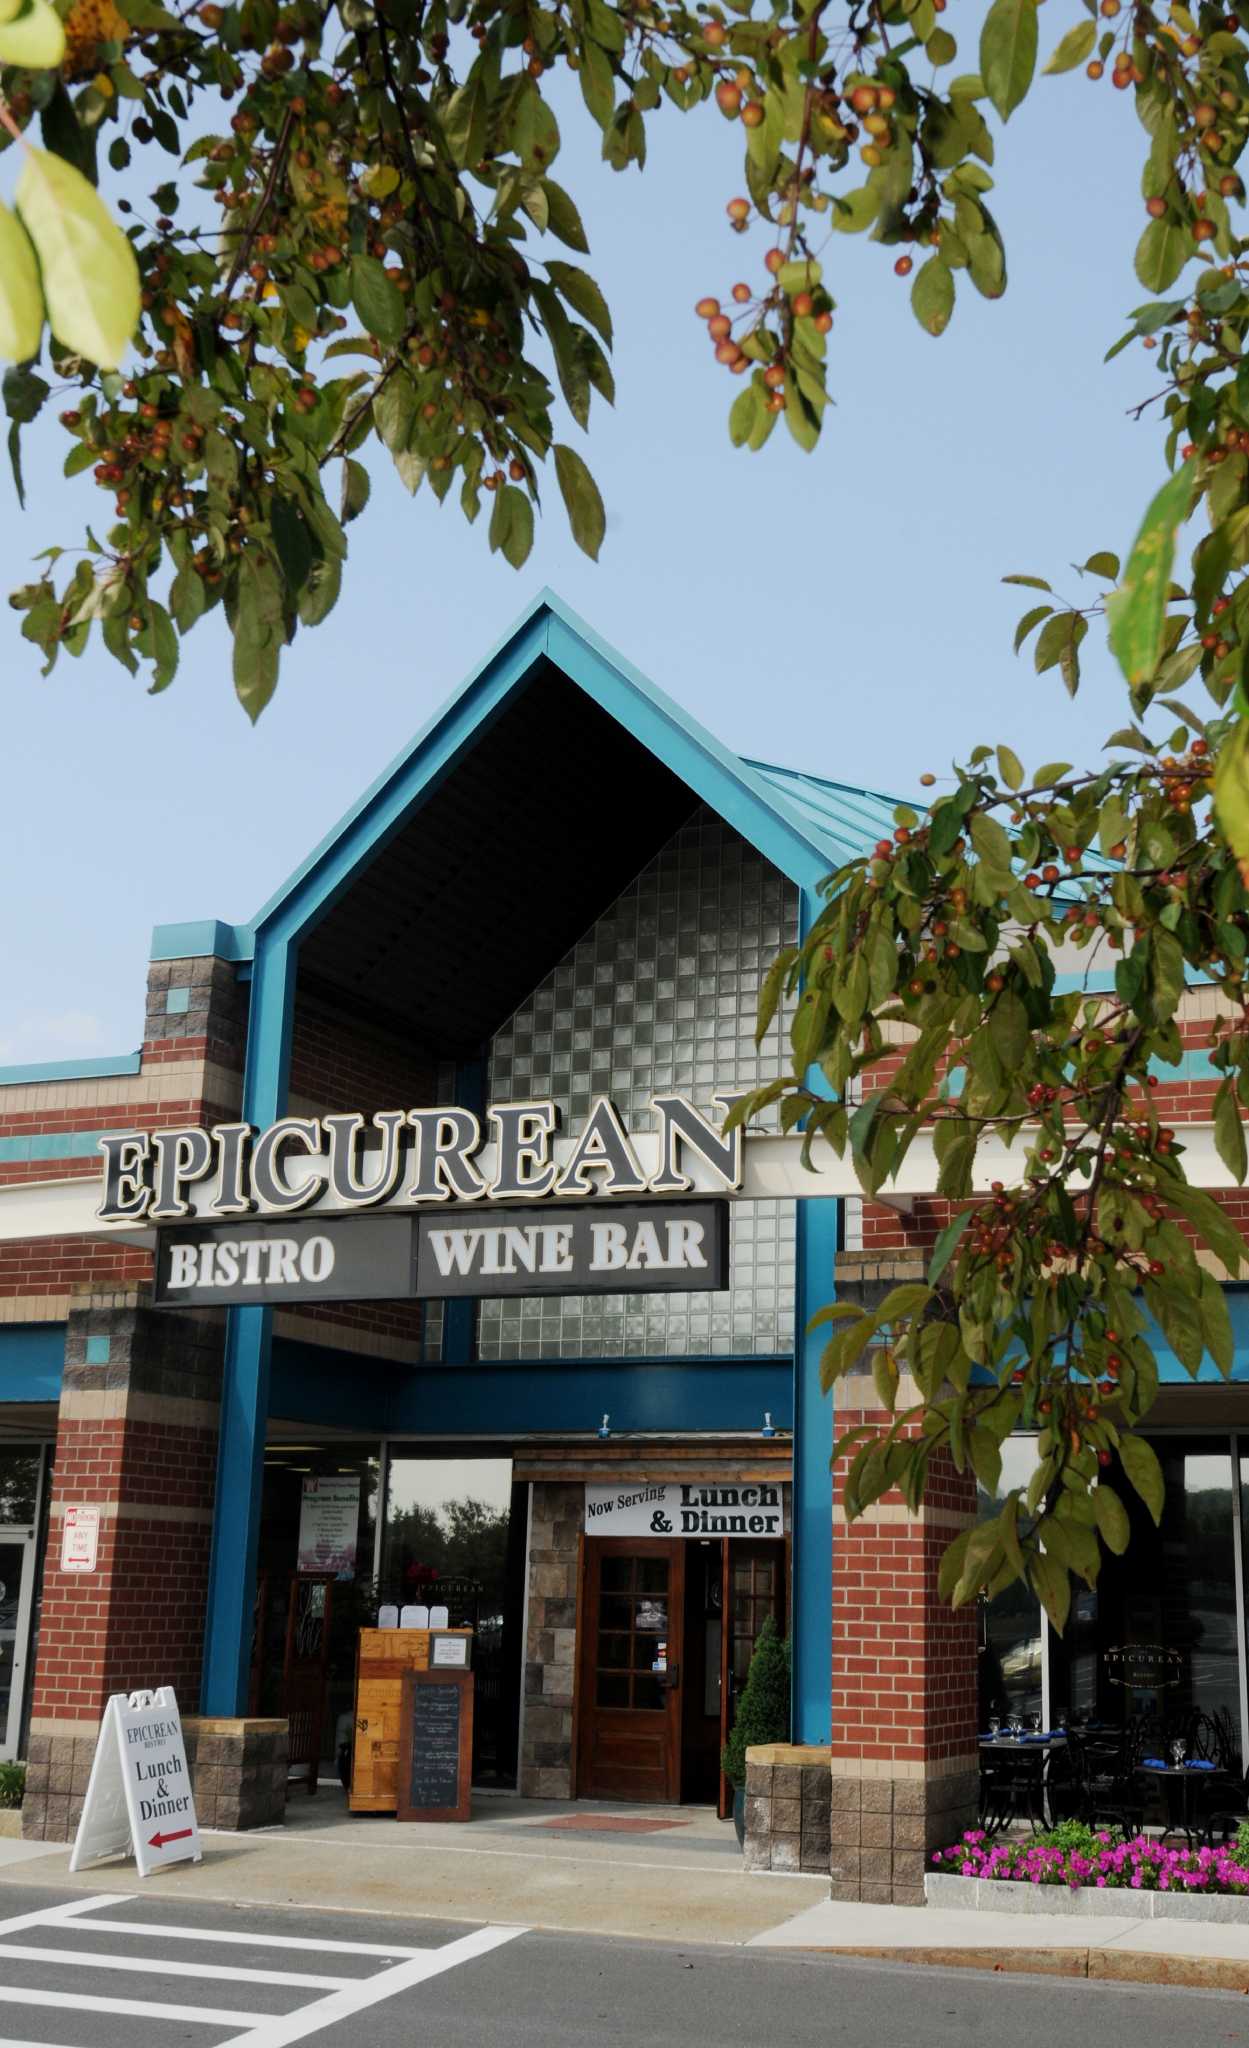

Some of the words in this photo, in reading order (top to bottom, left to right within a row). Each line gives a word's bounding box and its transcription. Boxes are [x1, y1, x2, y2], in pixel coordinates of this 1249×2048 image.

[95, 1091, 748, 1221] EPICUREAN
[167, 1235, 336, 1290] BISTRO
[427, 1223, 575, 1277] WINE
[589, 1219, 708, 1272] BAR
[587, 1500, 614, 1518] Now
[616, 1485, 667, 1511] Serving
[679, 1484, 780, 1507] Lunch
[649, 1510, 673, 1533] &
[679, 1510, 780, 1533] Dinner
[73, 1530, 88, 1539] ANY
[72, 1543, 88, 1553] TIME
[1103, 1654, 1184, 1664] EPICUREAN
[126, 1720, 179, 1744] EPICUREAN
[136, 1753, 182, 1781] Lunch
[156, 1777, 169, 1799] &
[140, 1795, 190, 1821] Dinner
